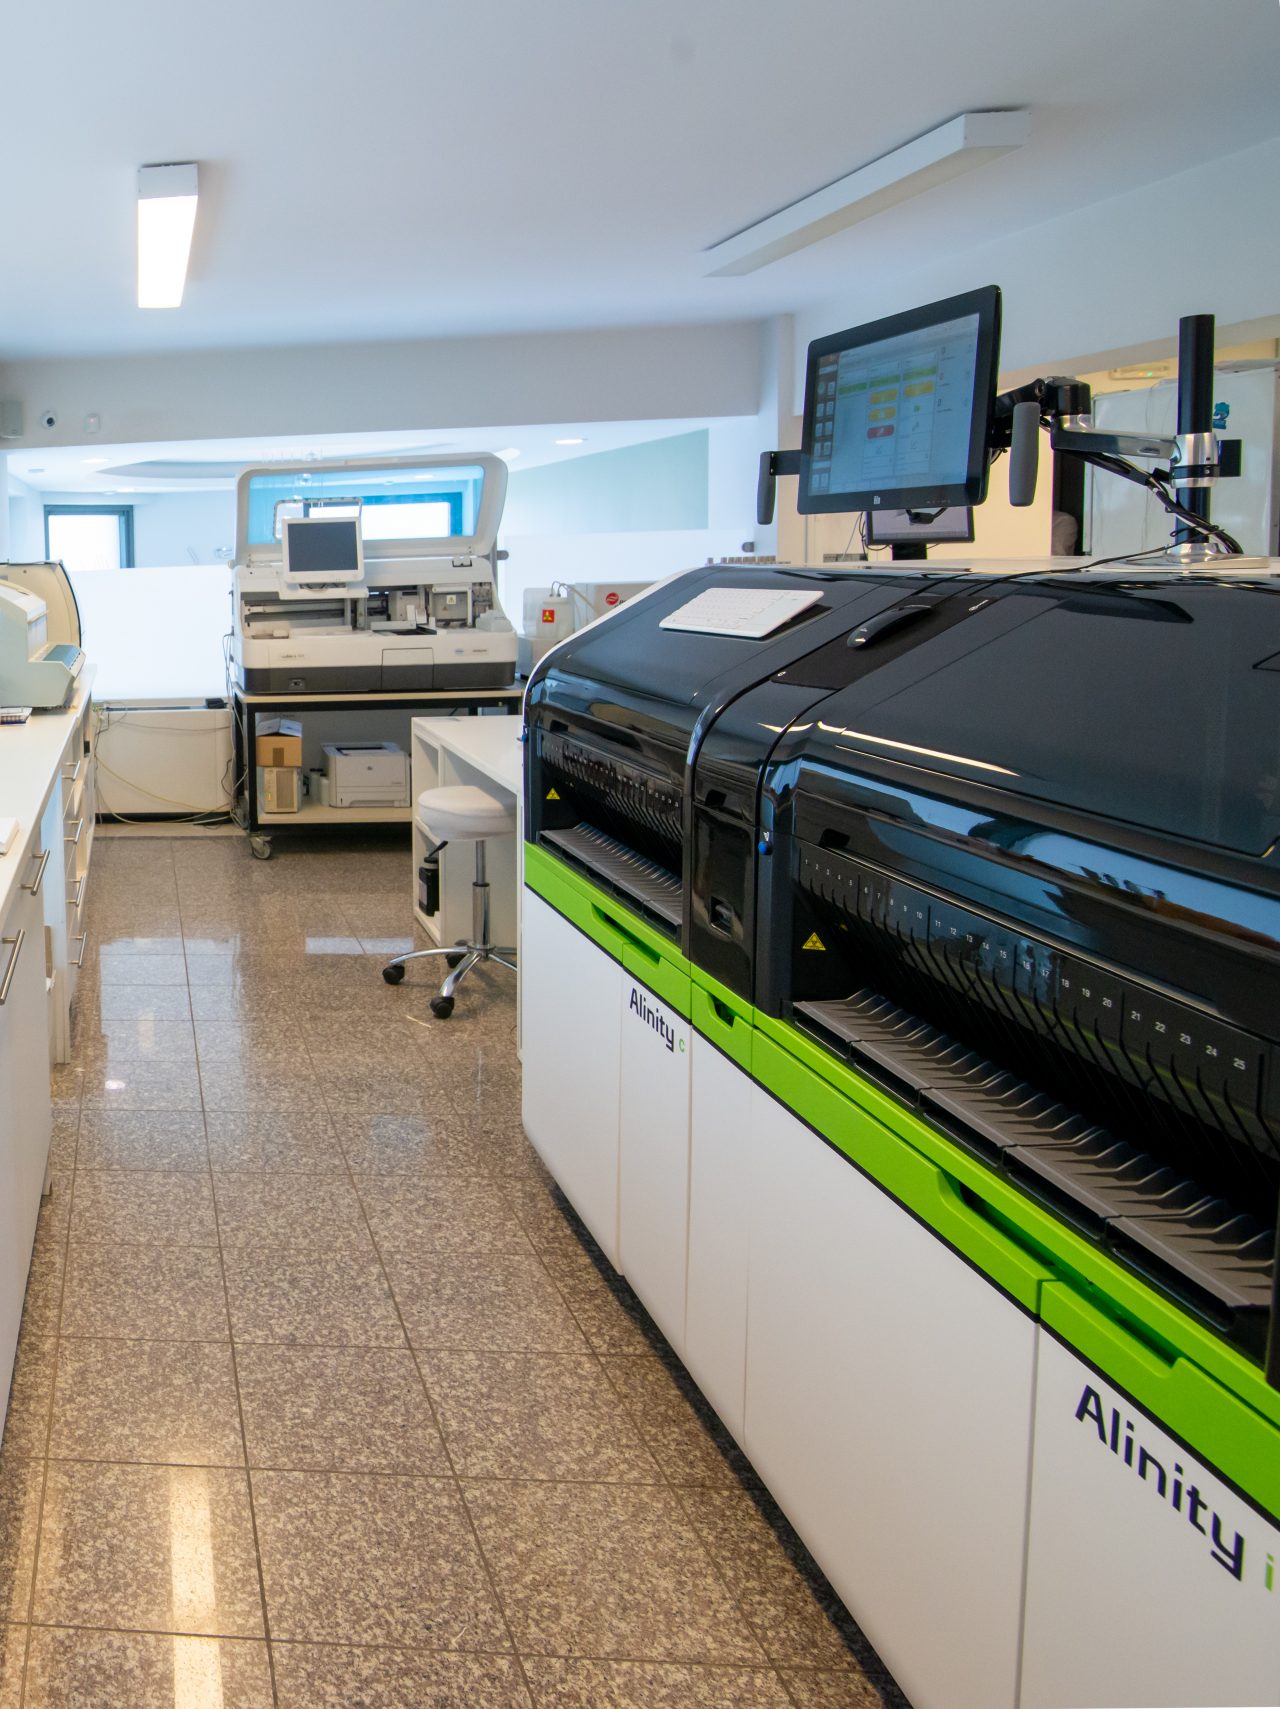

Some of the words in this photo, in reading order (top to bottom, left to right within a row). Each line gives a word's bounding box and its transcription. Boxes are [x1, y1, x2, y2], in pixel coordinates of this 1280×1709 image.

[630, 987, 674, 1053] Alinity
[678, 1038, 685, 1053] c
[916, 911, 923, 920] 10
[934, 919, 942, 929] 11
[950, 926, 958, 936] 12
[965, 933, 973, 944] 13
[982, 941, 990, 951] 14
[999, 949, 1007, 960] 15
[1022, 960, 1031, 971] 16
[1040, 968, 1050, 978] 17
[1061, 978, 1070, 989] 18
[1081, 987, 1091, 999] 19
[1102, 997, 1113, 1009] 20
[1130, 1010, 1142, 1022] 21
[1154, 1021, 1167, 1034] 22
[1179, 1033, 1192, 1046] 23
[1205, 1044, 1218, 1058] 24
[1232, 1057, 1246, 1071] 25
[1075, 1384, 1244, 1582] Alinity
[1265, 1553, 1274, 1592] i
